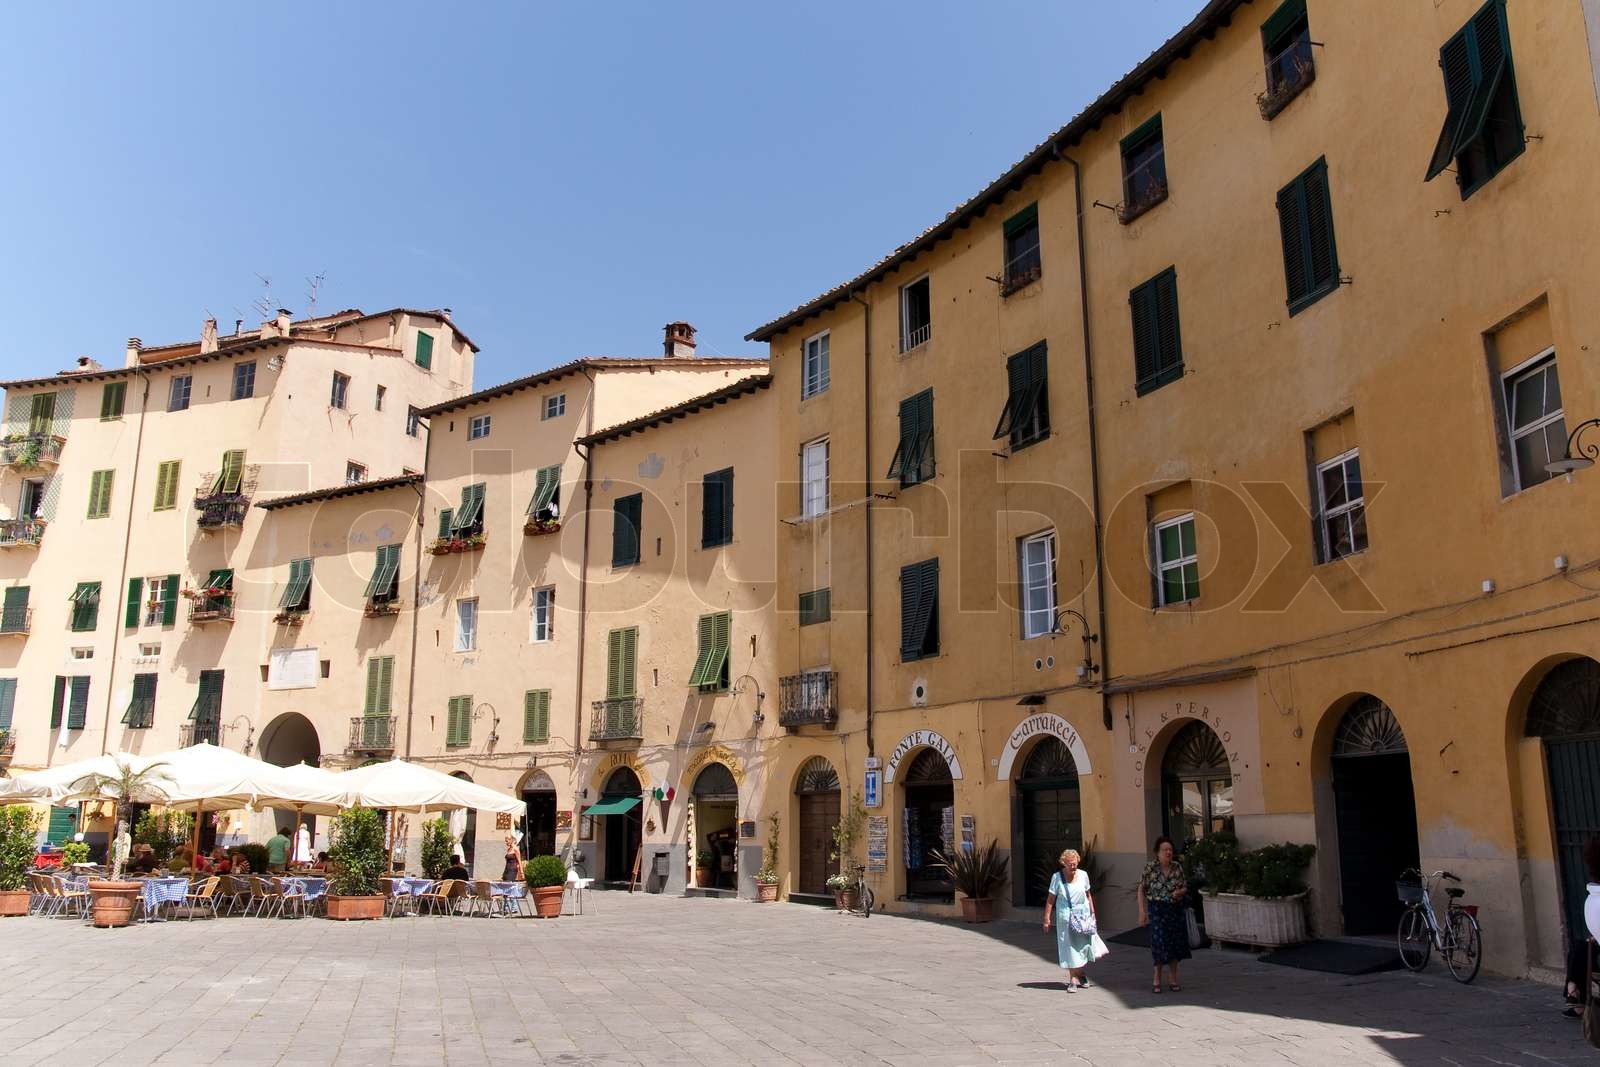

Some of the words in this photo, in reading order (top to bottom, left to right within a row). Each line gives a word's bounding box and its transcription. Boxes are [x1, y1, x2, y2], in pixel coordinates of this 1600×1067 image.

[889, 731, 922, 769] FONTE
[928, 732, 954, 766] GAIA
[1135, 729, 1154, 788] COSE
[1175, 702, 1241, 784] PERSONE
